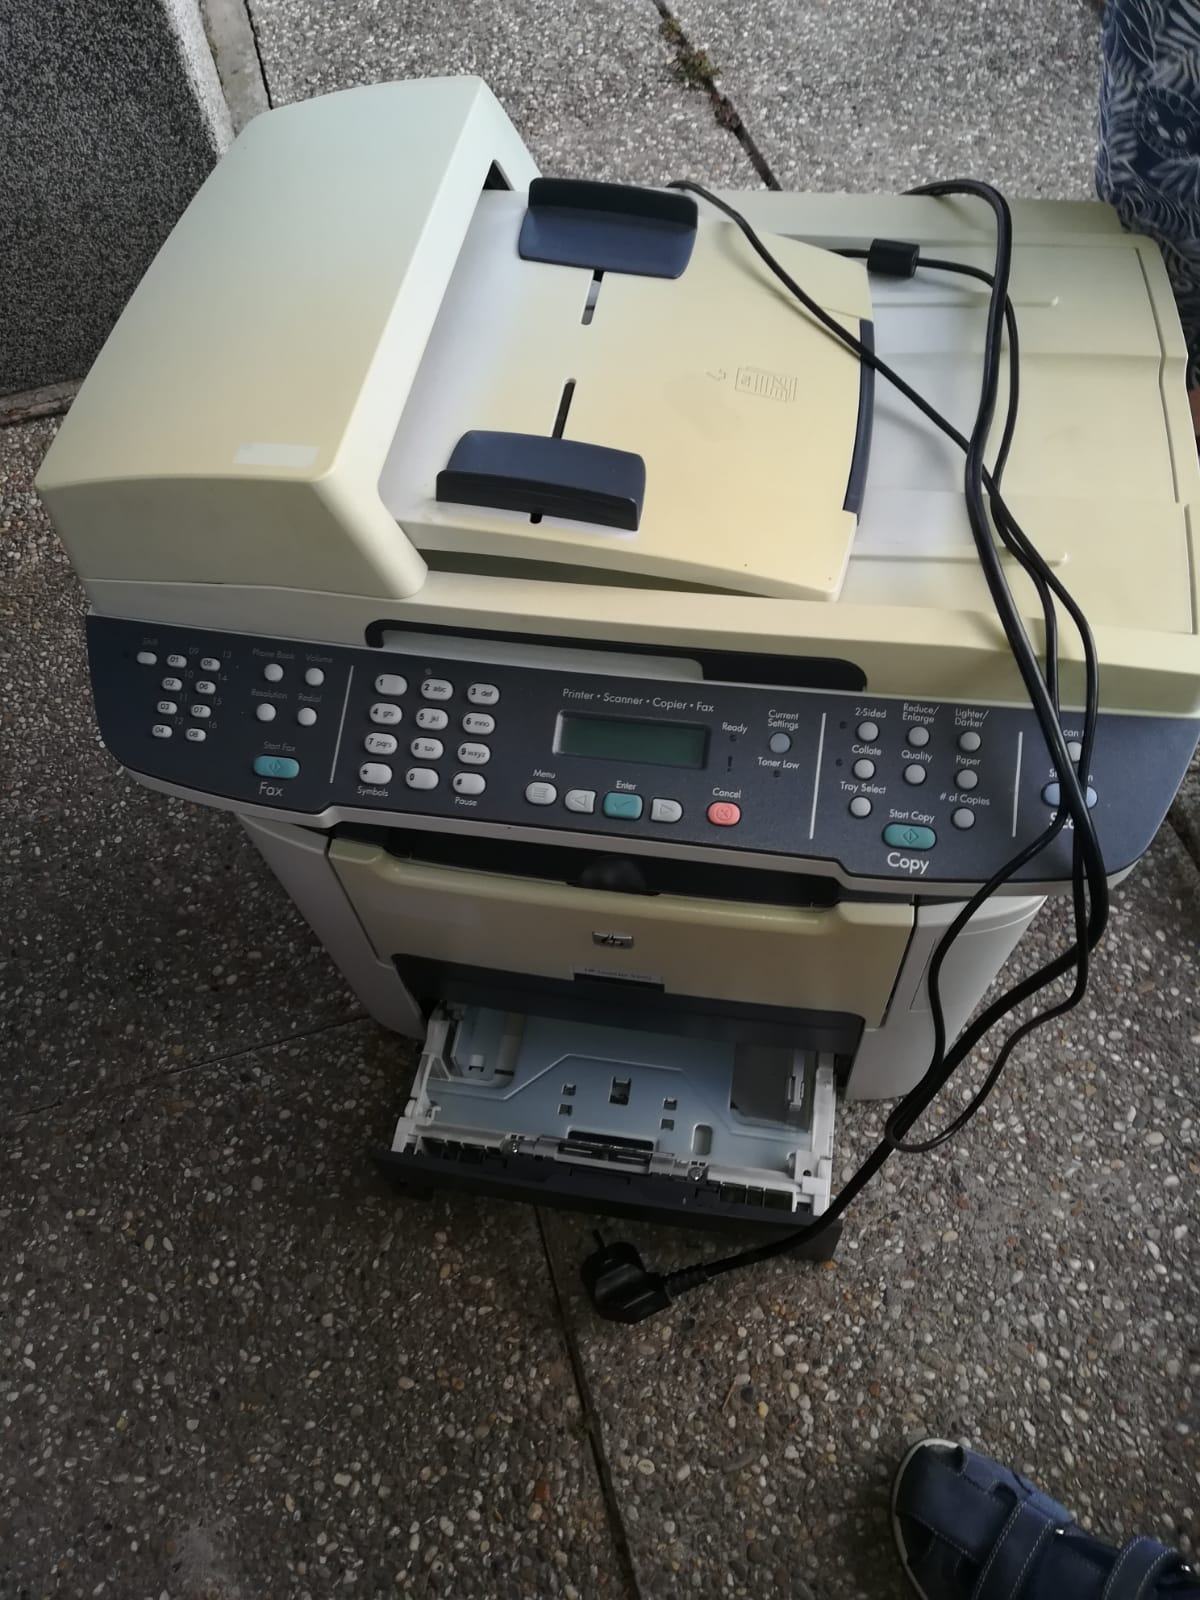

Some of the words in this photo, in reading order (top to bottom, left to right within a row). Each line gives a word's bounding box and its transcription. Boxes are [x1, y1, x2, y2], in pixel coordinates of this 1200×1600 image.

[562, 688, 594, 701] Printer
[603, 692, 643, 706] Scanner
[652, 697, 687, 711] Copier
[696, 701, 715, 713] Fax
[768, 709, 799, 721] Current
[855, 707, 887, 719] 2-Sided
[903, 703, 940, 715] Reduce/
[955, 708, 989, 721] Lighter/
[902, 713, 935, 725] Enlarge
[955, 717, 984, 728] Darker
[722, 721, 748, 735] Ready
[767, 719, 799, 732] Settings
[280, 742, 296, 753] Fax
[851, 745, 882, 757] Collate
[901, 750, 933, 763] Quality
[956, 755, 981, 767] Paper
[758, 756, 781, 768] Toner
[782, 758, 800, 770] Low
[533, 769, 556, 780] Menu
[259, 781, 284, 797] Fax
[357, 785, 389, 797] Symbols
[616, 780, 637, 791] Enter
[840, 781, 859, 794] Tray
[860, 782, 887, 795] Select
[712, 788, 742, 800] Cancel
[939, 792, 947, 801] #
[948, 793, 958, 803] of
[959, 794, 990, 806] Copies
[455, 796, 478, 807] Pause
[889, 808, 909, 820] Start
[911, 811, 935, 824] Copy
[887, 852, 930, 874] Copy
